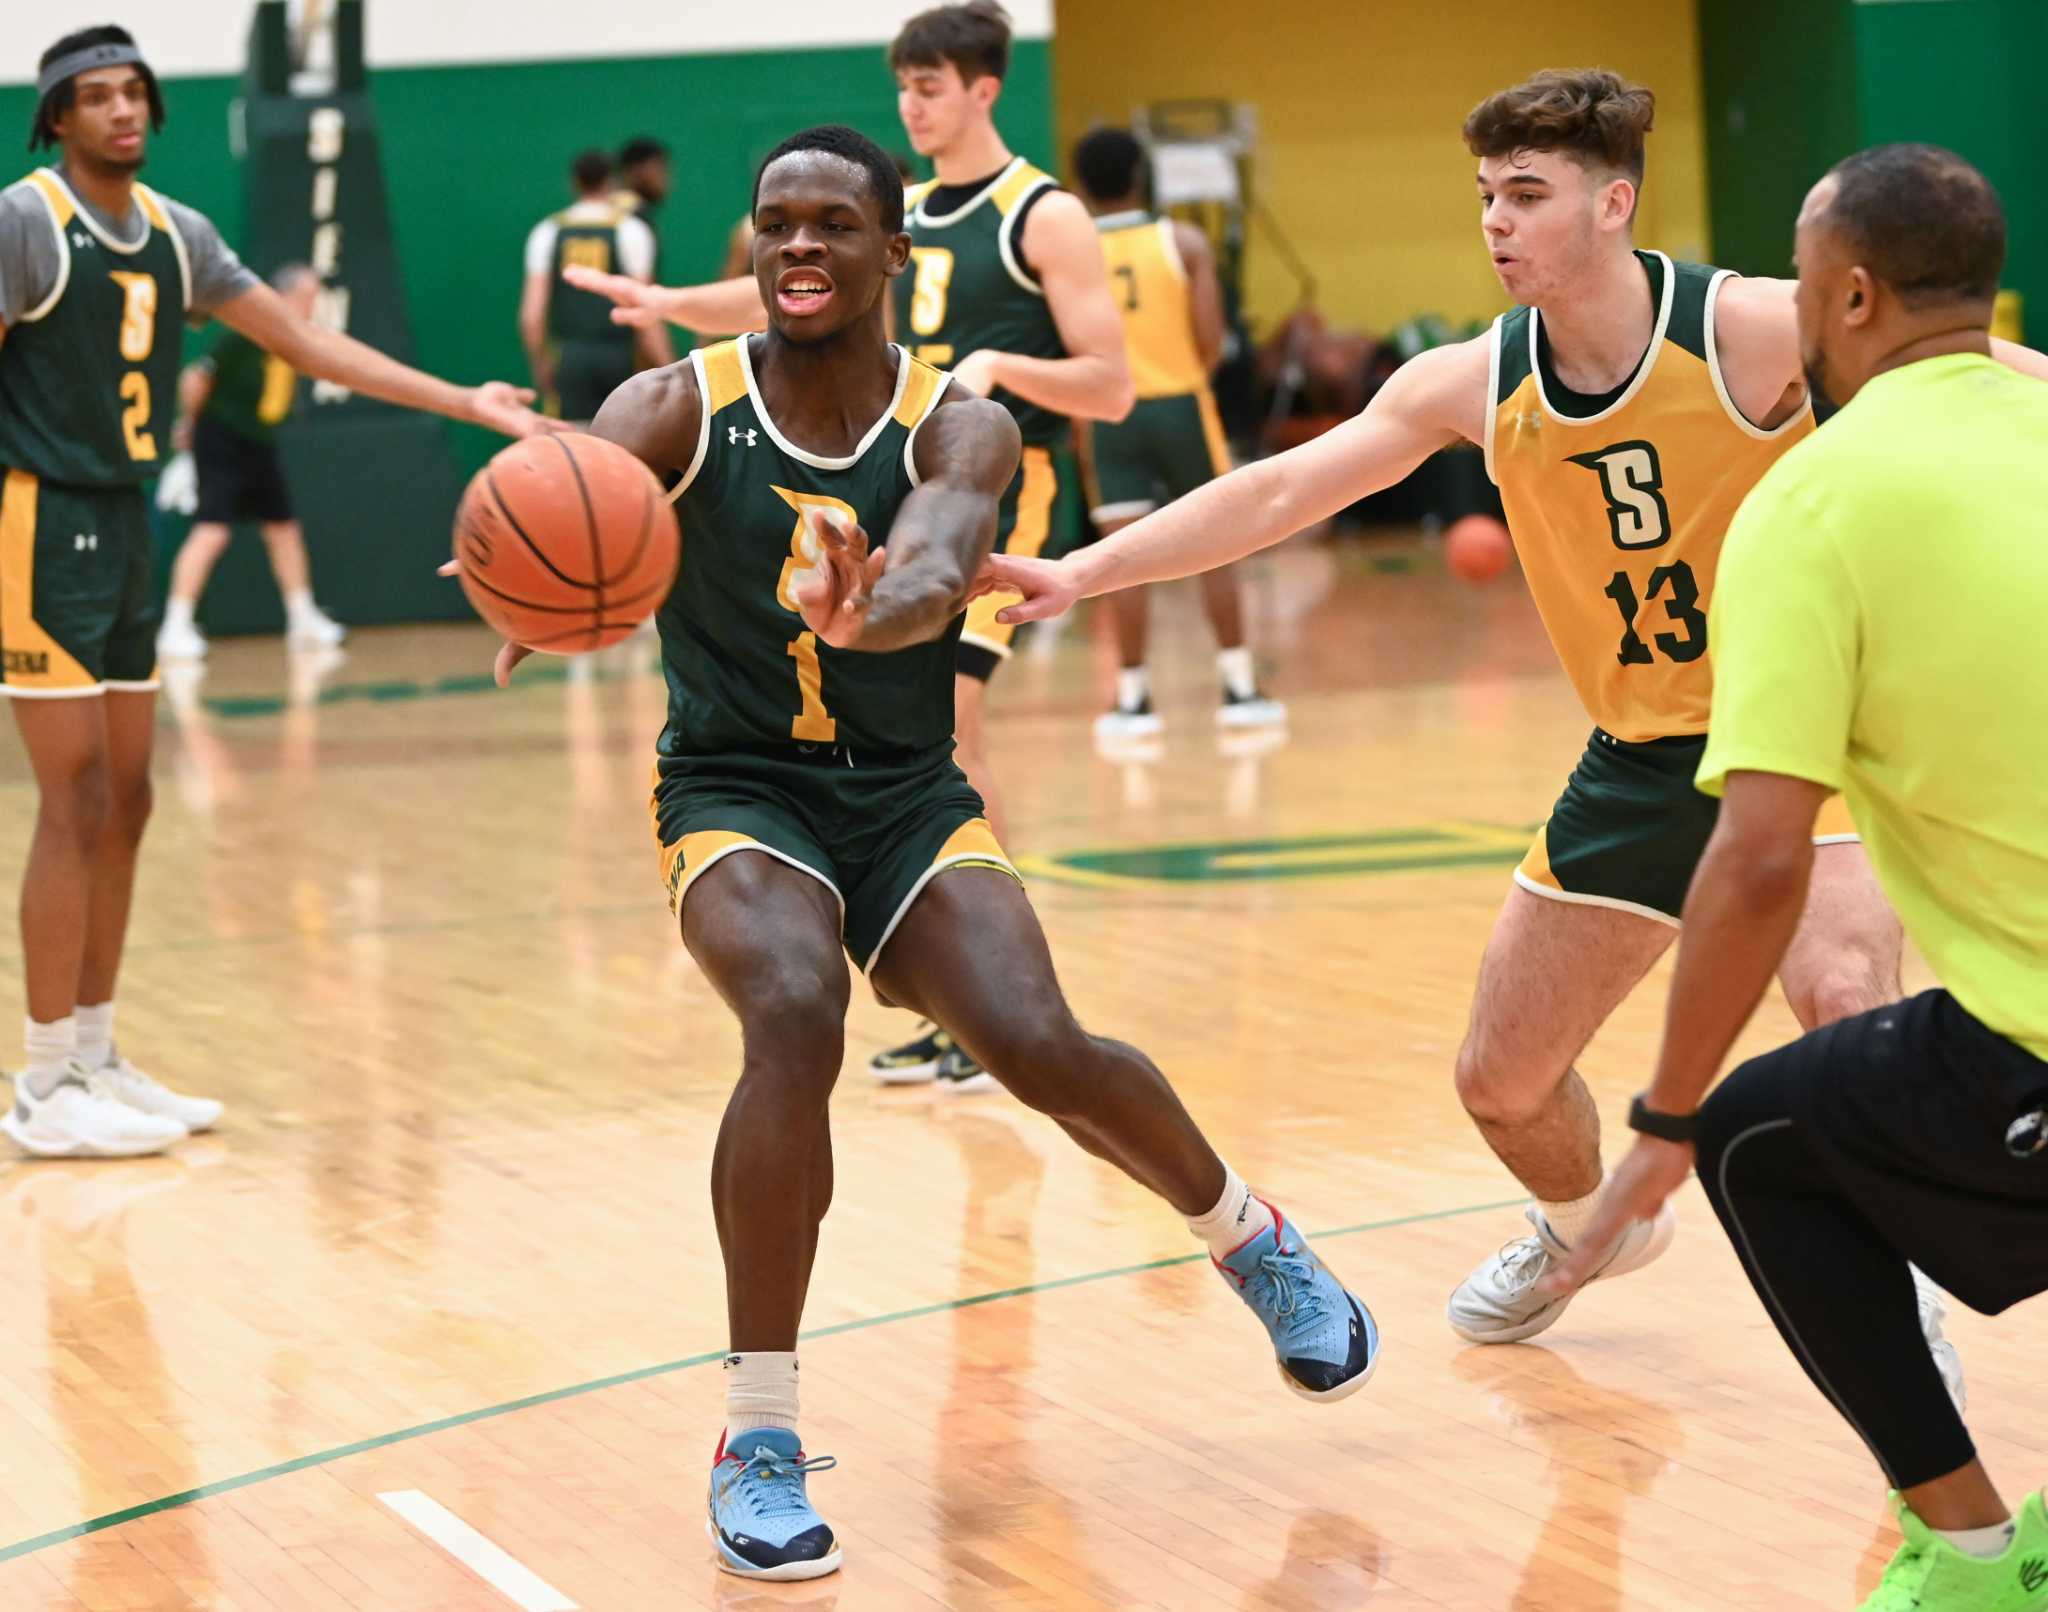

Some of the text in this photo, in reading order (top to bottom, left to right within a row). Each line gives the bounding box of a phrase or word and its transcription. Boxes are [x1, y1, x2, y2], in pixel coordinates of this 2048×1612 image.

[110, 272, 156, 362] S
[119, 371, 157, 461] 2
[1563, 440, 1672, 551] S
[1604, 560, 1708, 667] 13
[787, 631, 836, 742] 1
